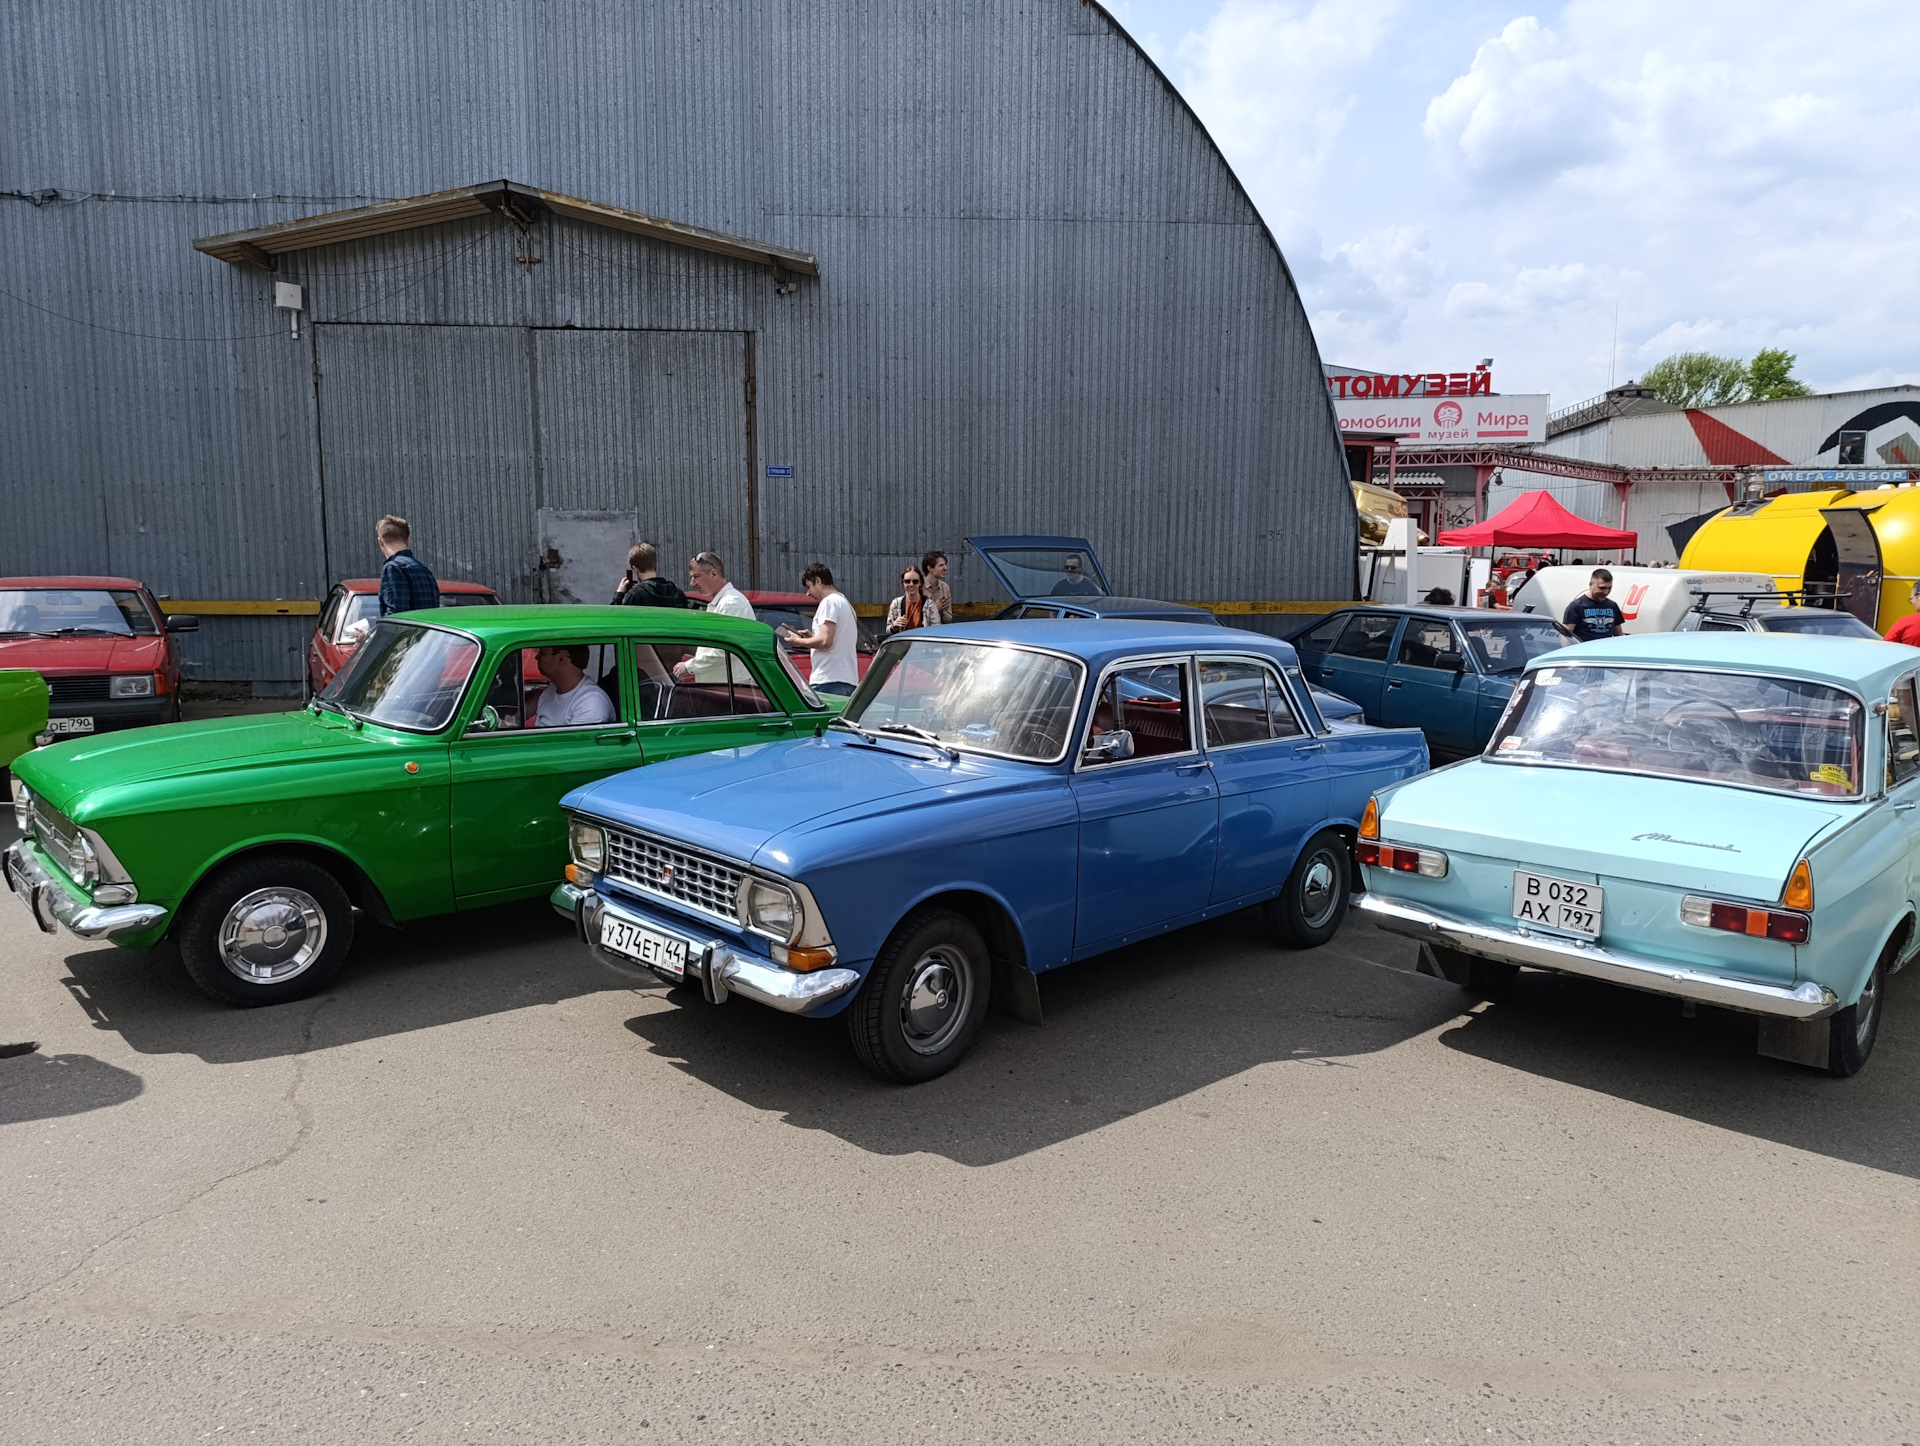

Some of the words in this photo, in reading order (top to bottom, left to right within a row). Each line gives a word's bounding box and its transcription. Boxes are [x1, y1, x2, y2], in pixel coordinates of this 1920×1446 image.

[1477, 412, 1529, 429] Мира
[1428, 428, 1469, 441] музей
[1768, 471, 1903, 481] ОМЕГА-РАЗБОР
[70, 718, 90, 728] 790
[1549, 882, 1588, 906] 032
[1520, 900, 1551, 922] АХ
[1563, 908, 1594, 926] 797
[1570, 923, 1584, 931] RUS
[607, 923, 661, 961] У374ЕТ
[665, 941, 680, 962] 44
[663, 959, 674, 969] RUS
